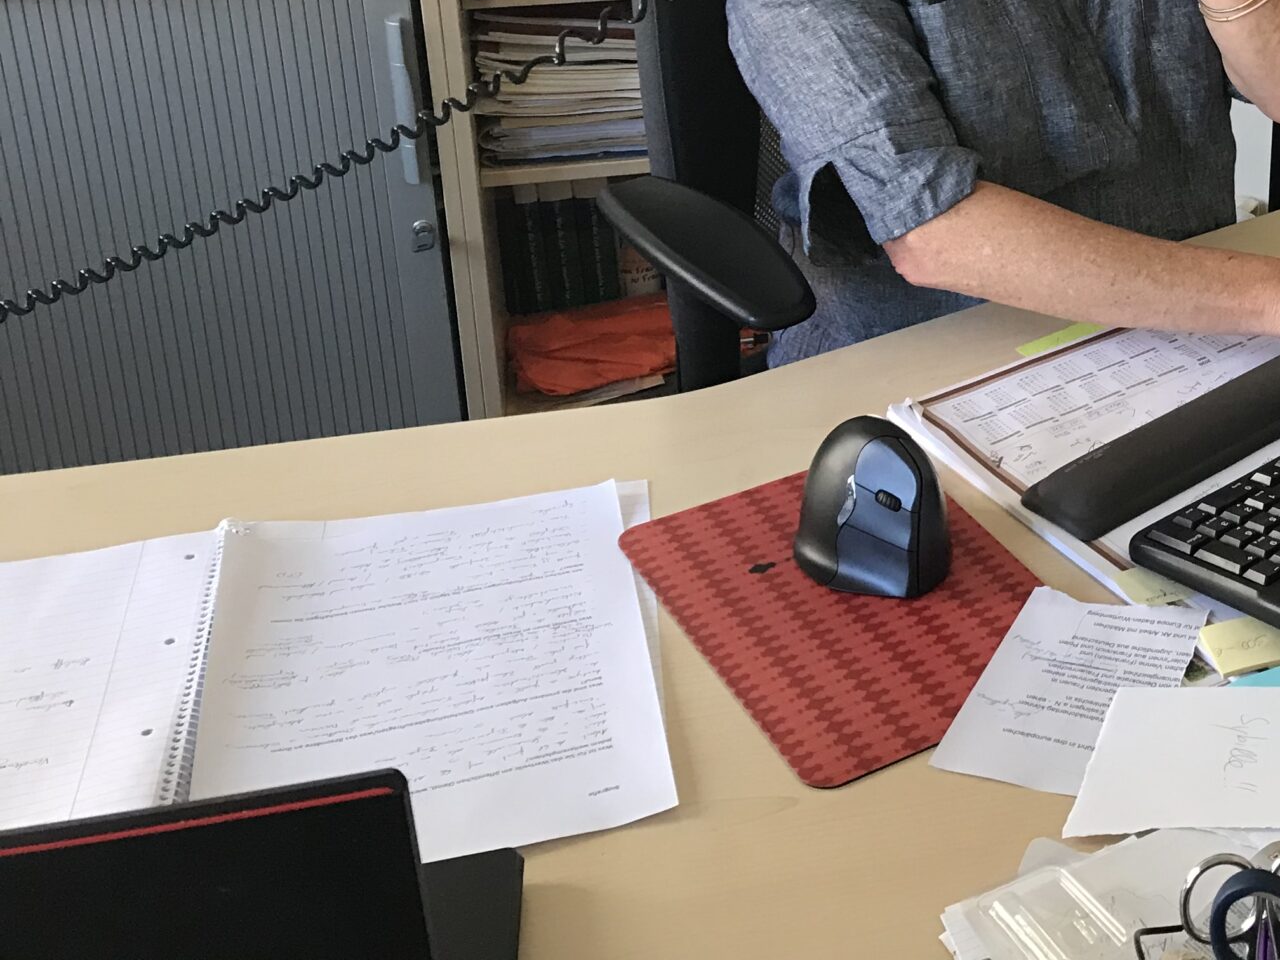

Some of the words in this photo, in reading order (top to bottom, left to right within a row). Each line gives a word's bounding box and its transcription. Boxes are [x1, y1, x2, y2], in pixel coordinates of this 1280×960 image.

[1093, 621, 1125, 631] Mädchen
[1071, 634, 1115, 647] Deutschland
[1094, 646, 1132, 657] Frankreich
[1130, 645, 1173, 655] Jugendliche
[1058, 678, 1084, 689] Frauen
[1115, 675, 1157, 687] Demokratie
[1001, 726, 1052, 743] europäischen
